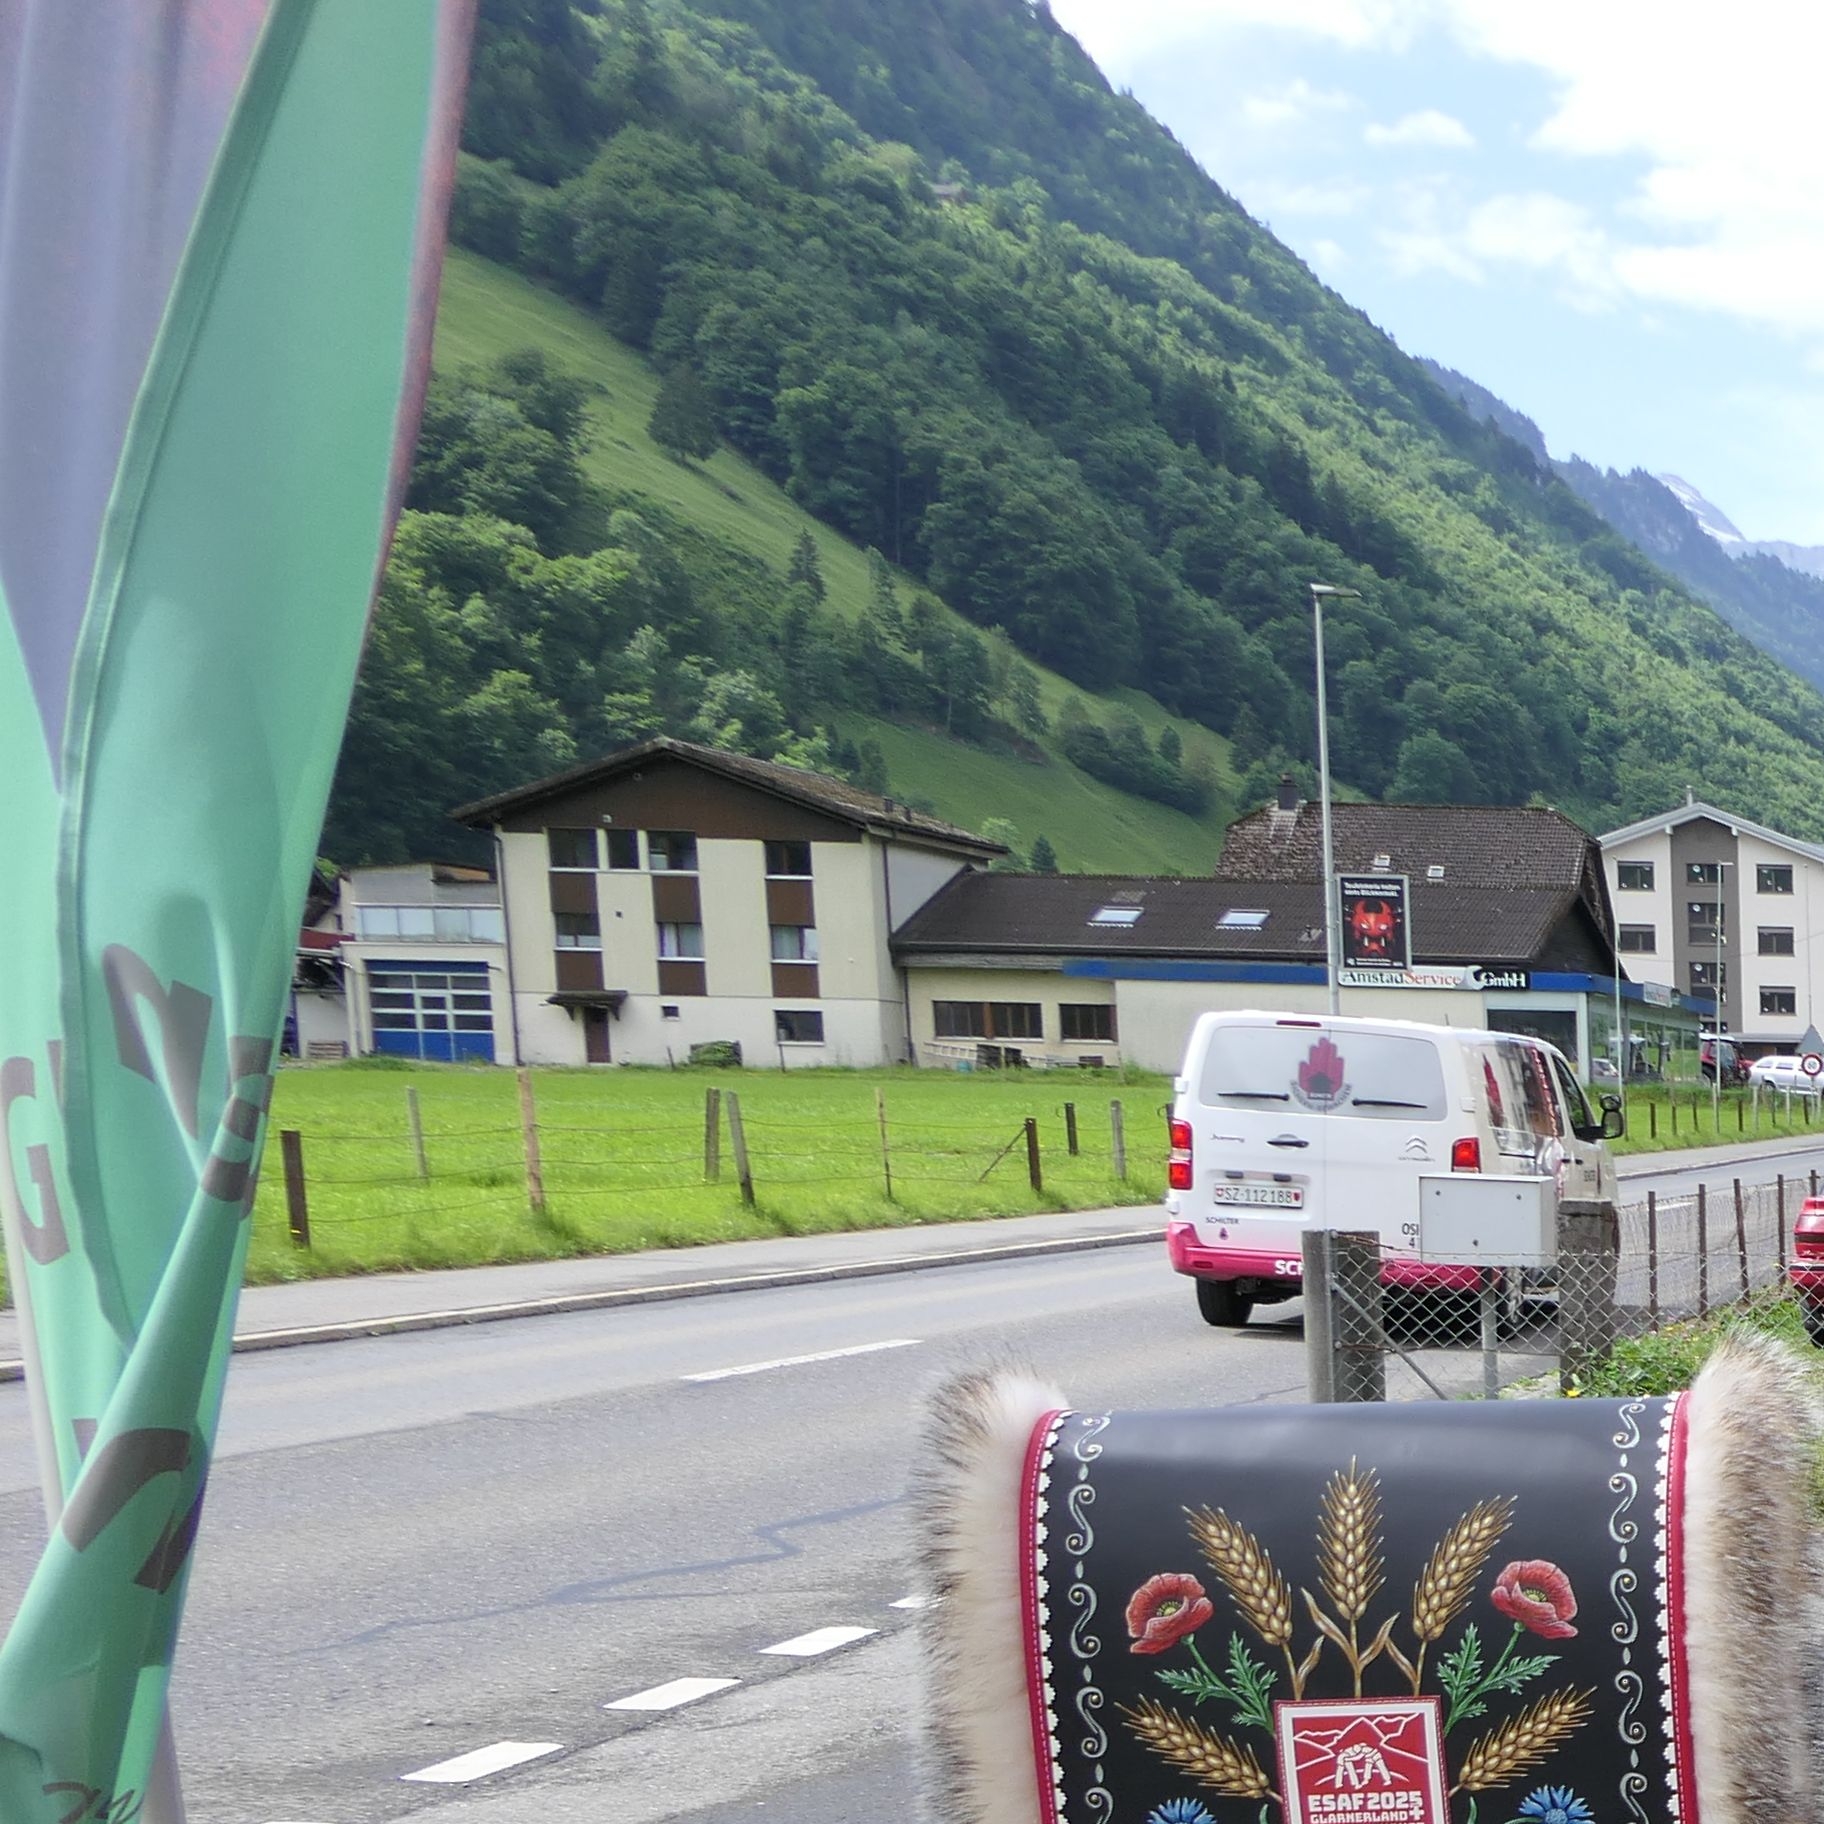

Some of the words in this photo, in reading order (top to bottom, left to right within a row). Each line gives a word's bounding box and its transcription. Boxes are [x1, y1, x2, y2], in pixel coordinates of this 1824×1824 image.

[1481, 971, 1527, 988] GmbH
[1308, 1793, 1364, 1812] ESAF
[1366, 1790, 1423, 1810] 2025
